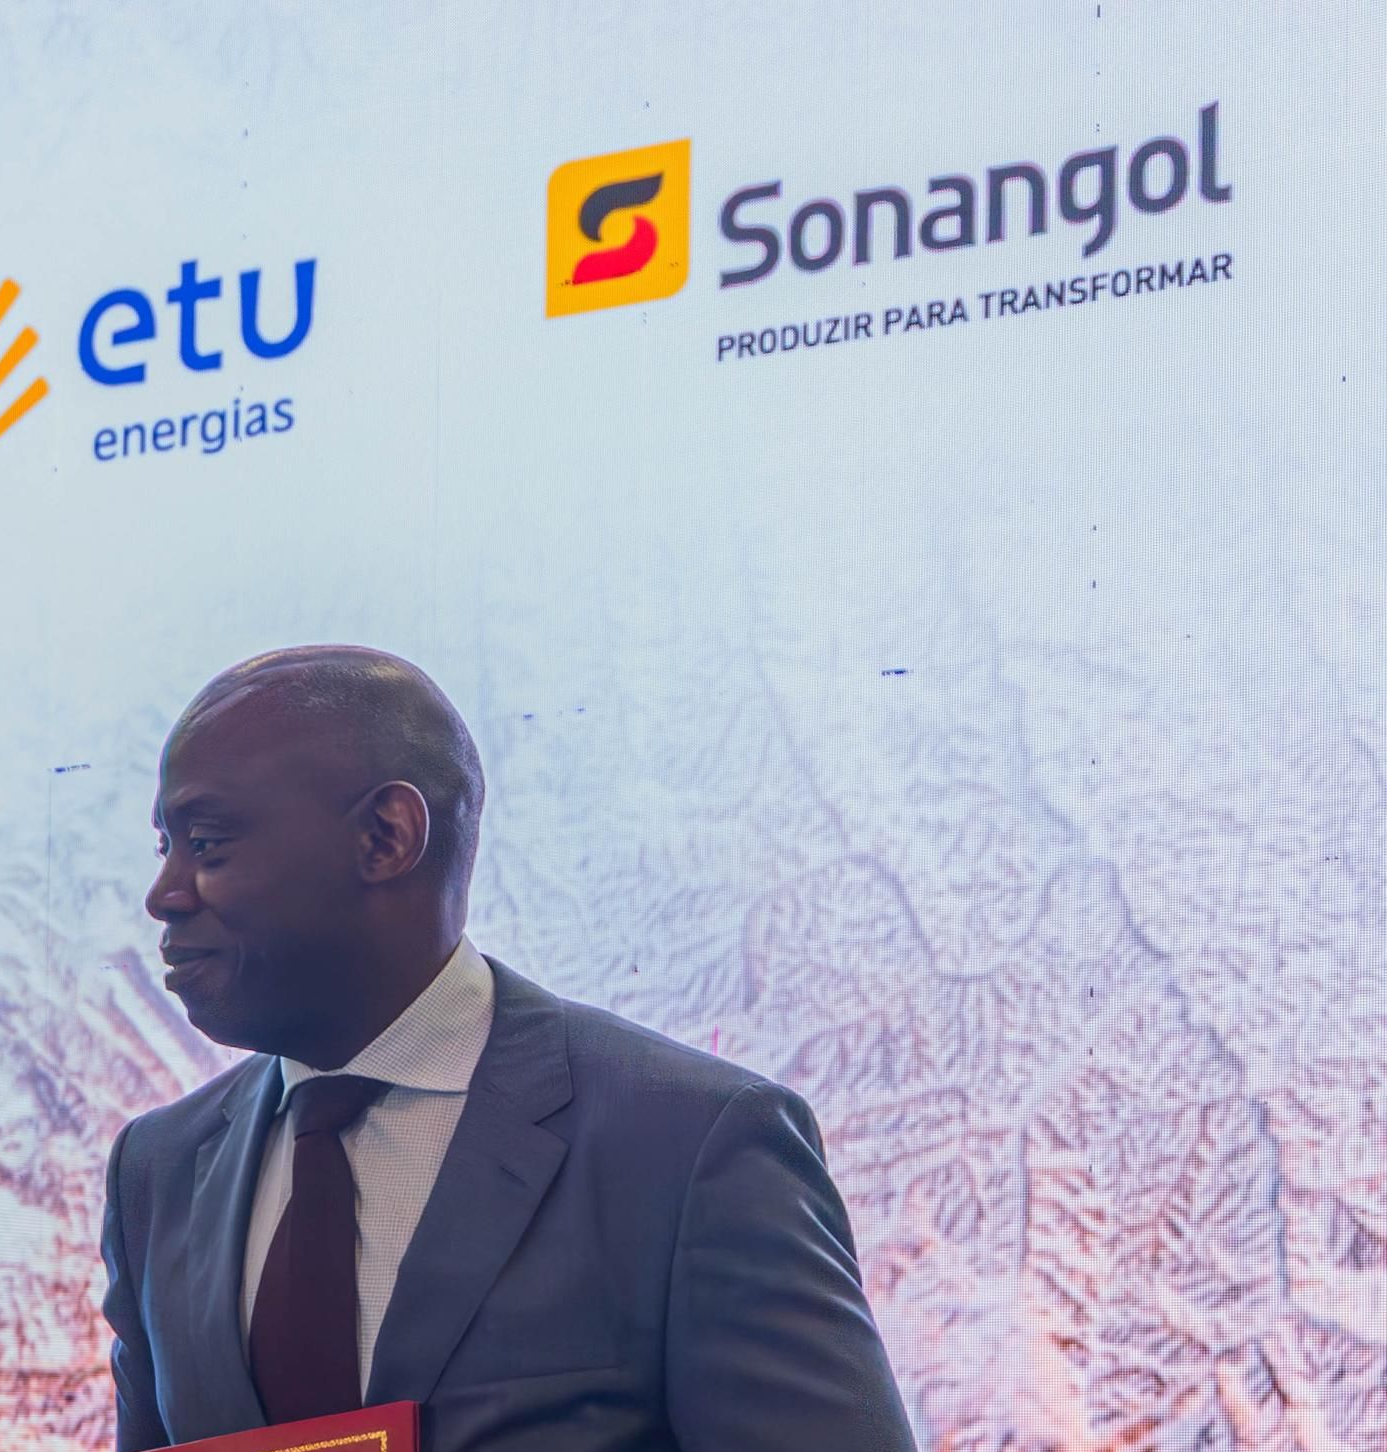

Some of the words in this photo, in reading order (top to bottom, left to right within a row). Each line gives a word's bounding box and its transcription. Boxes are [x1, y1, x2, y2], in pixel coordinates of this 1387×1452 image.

[718, 101, 1233, 289] Sonangol
[77, 257, 318, 387] etu
[717, 312, 872, 362] PRODUZIR
[884, 297, 970, 337] PARA
[978, 253, 1234, 320] TRANSFORMAR
[93, 397, 295, 462] energias
